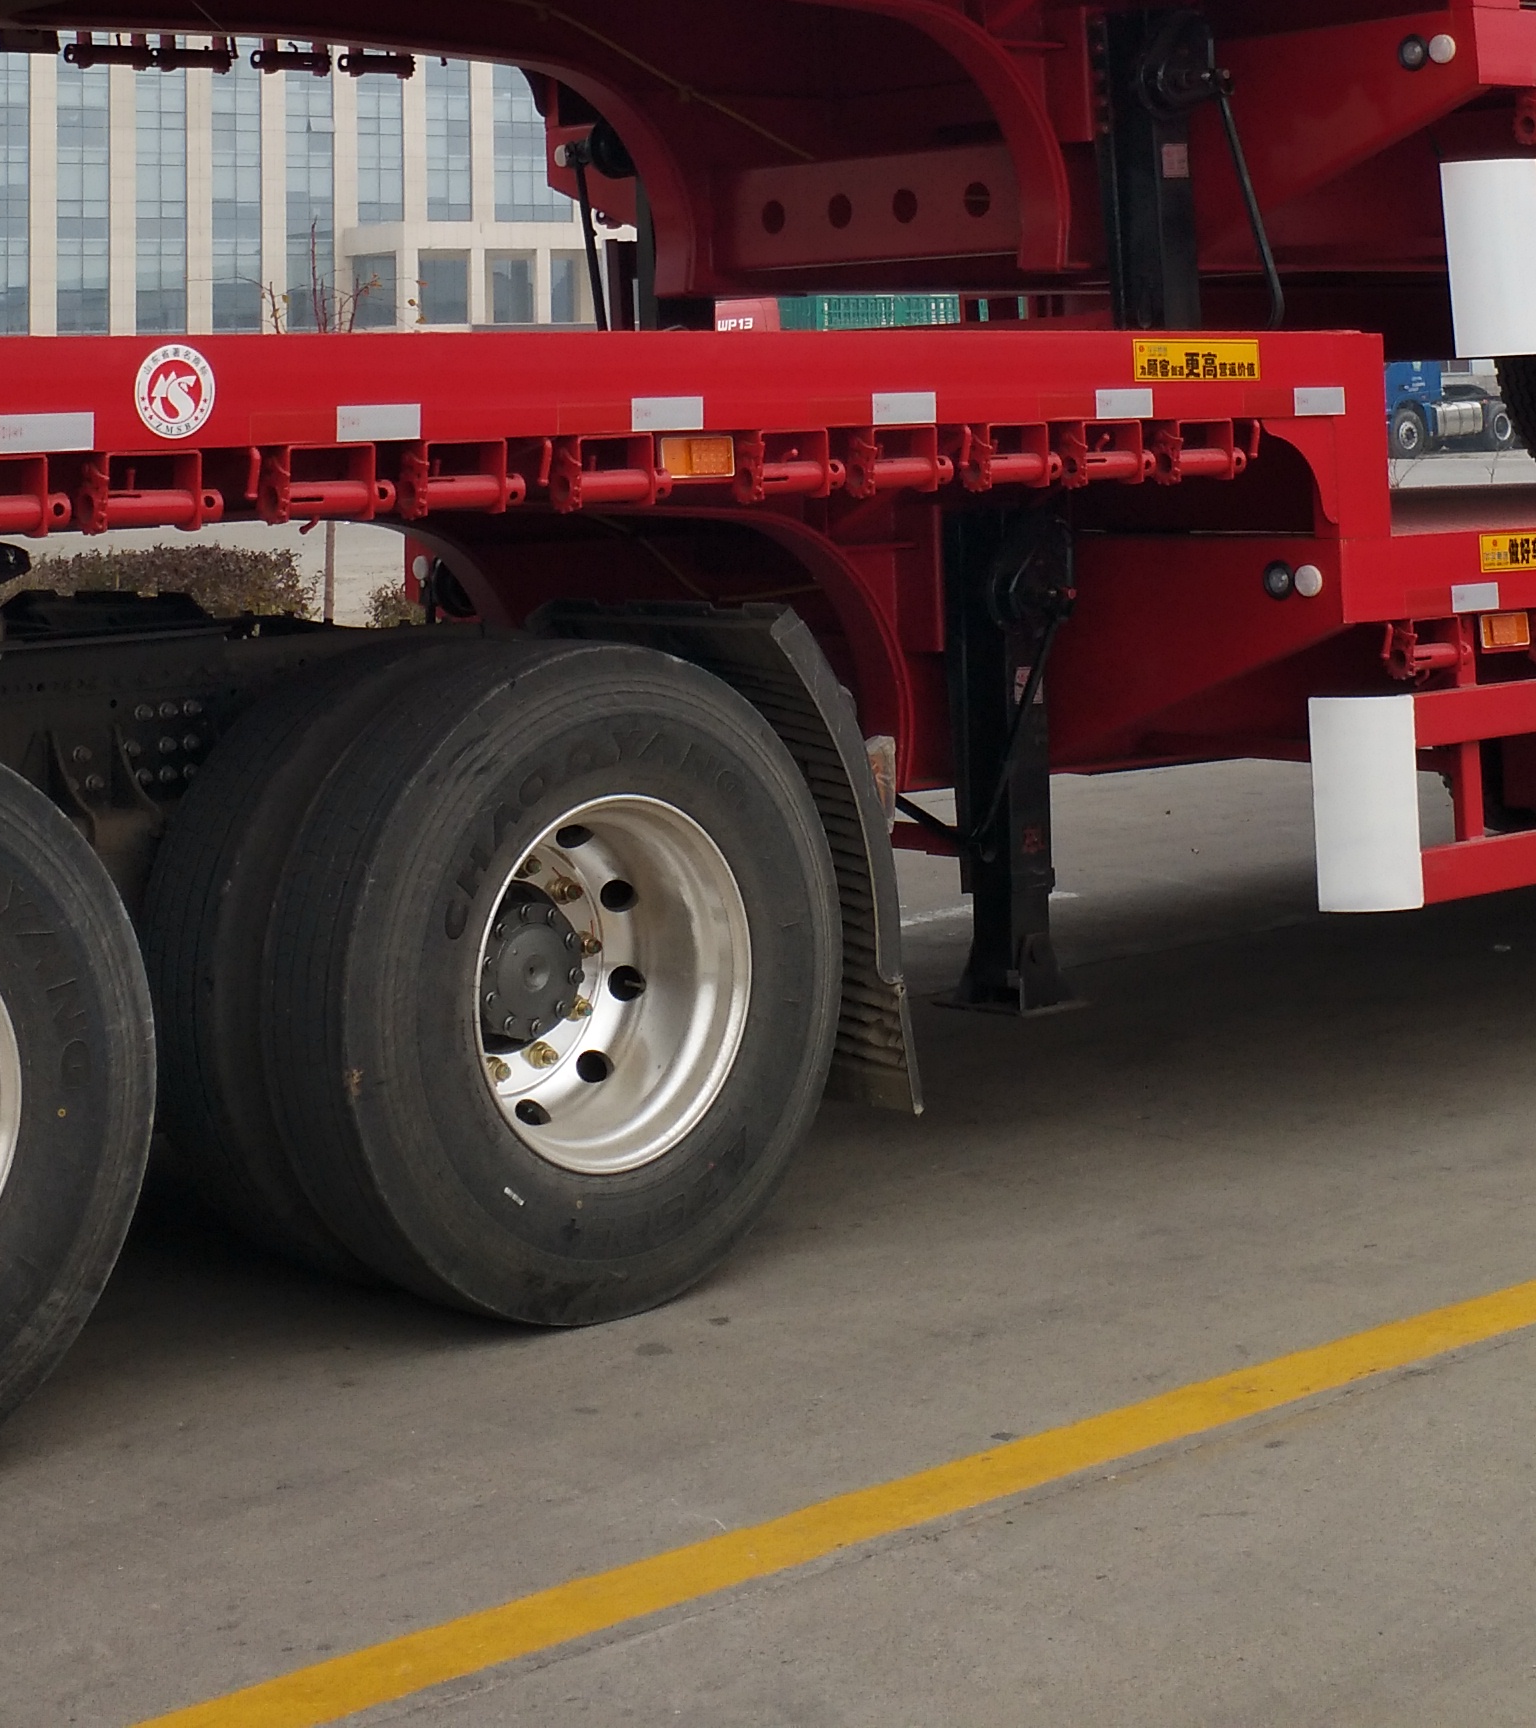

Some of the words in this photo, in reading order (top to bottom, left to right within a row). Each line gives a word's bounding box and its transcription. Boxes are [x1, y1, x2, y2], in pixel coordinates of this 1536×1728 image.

[717, 317, 753, 331] WP13
[143, 347, 209, 377] 山东省著名商标
